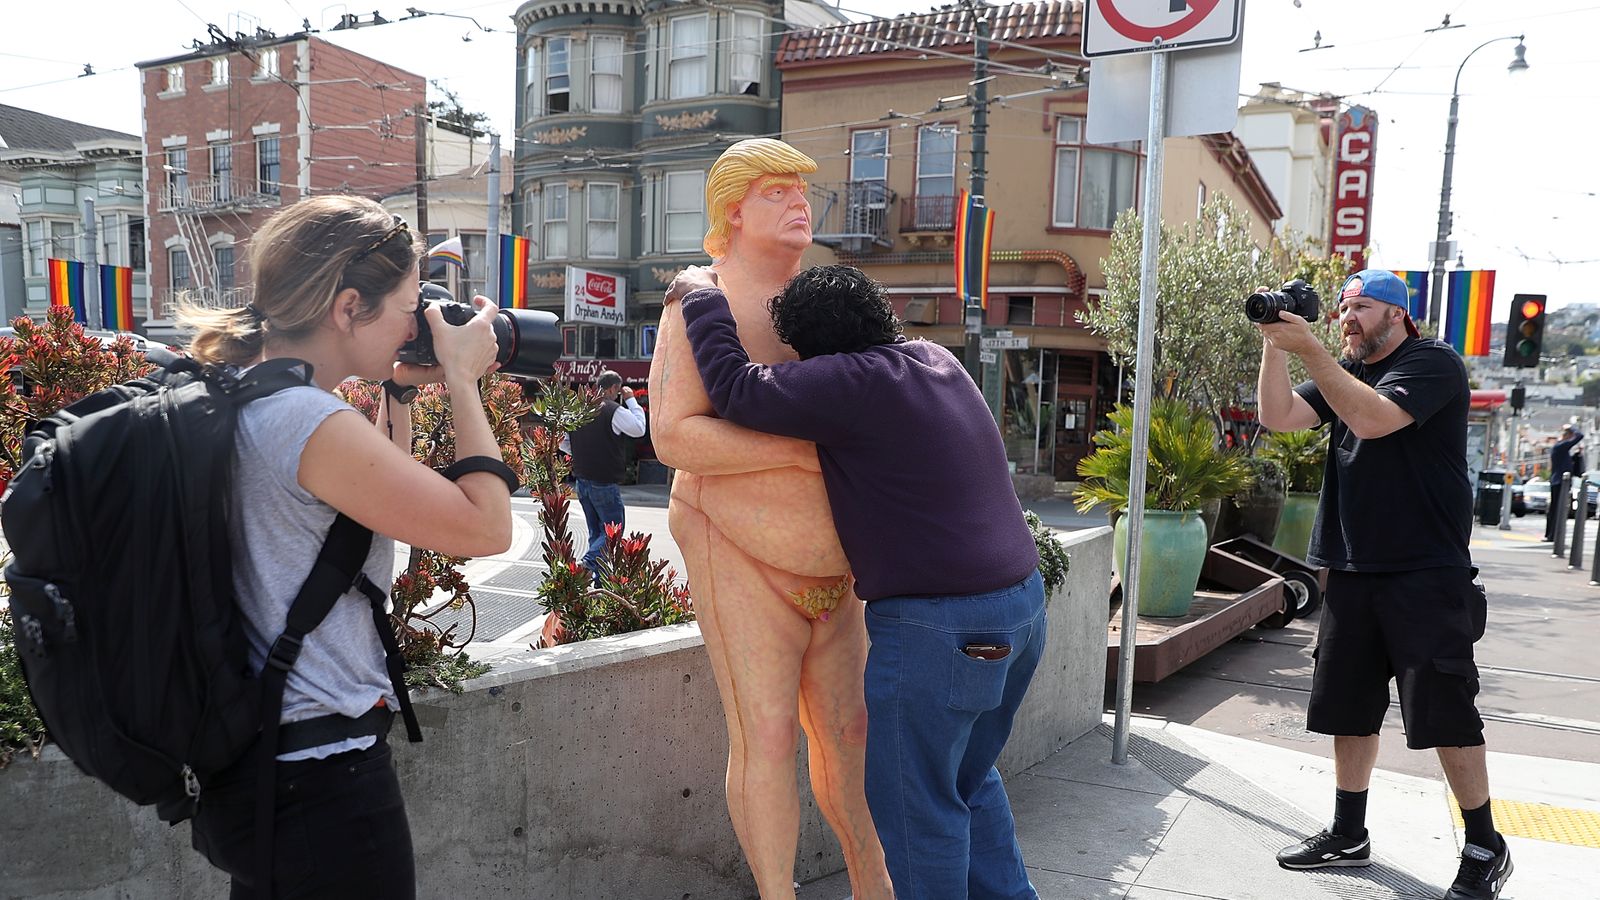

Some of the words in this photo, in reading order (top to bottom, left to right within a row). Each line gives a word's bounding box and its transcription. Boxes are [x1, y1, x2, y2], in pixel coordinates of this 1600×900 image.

[575, 284, 585, 296] 24
[575, 303, 599, 320] Orphan
[600, 307, 624, 324] Andy's
[566, 360, 607, 377] Andy's
